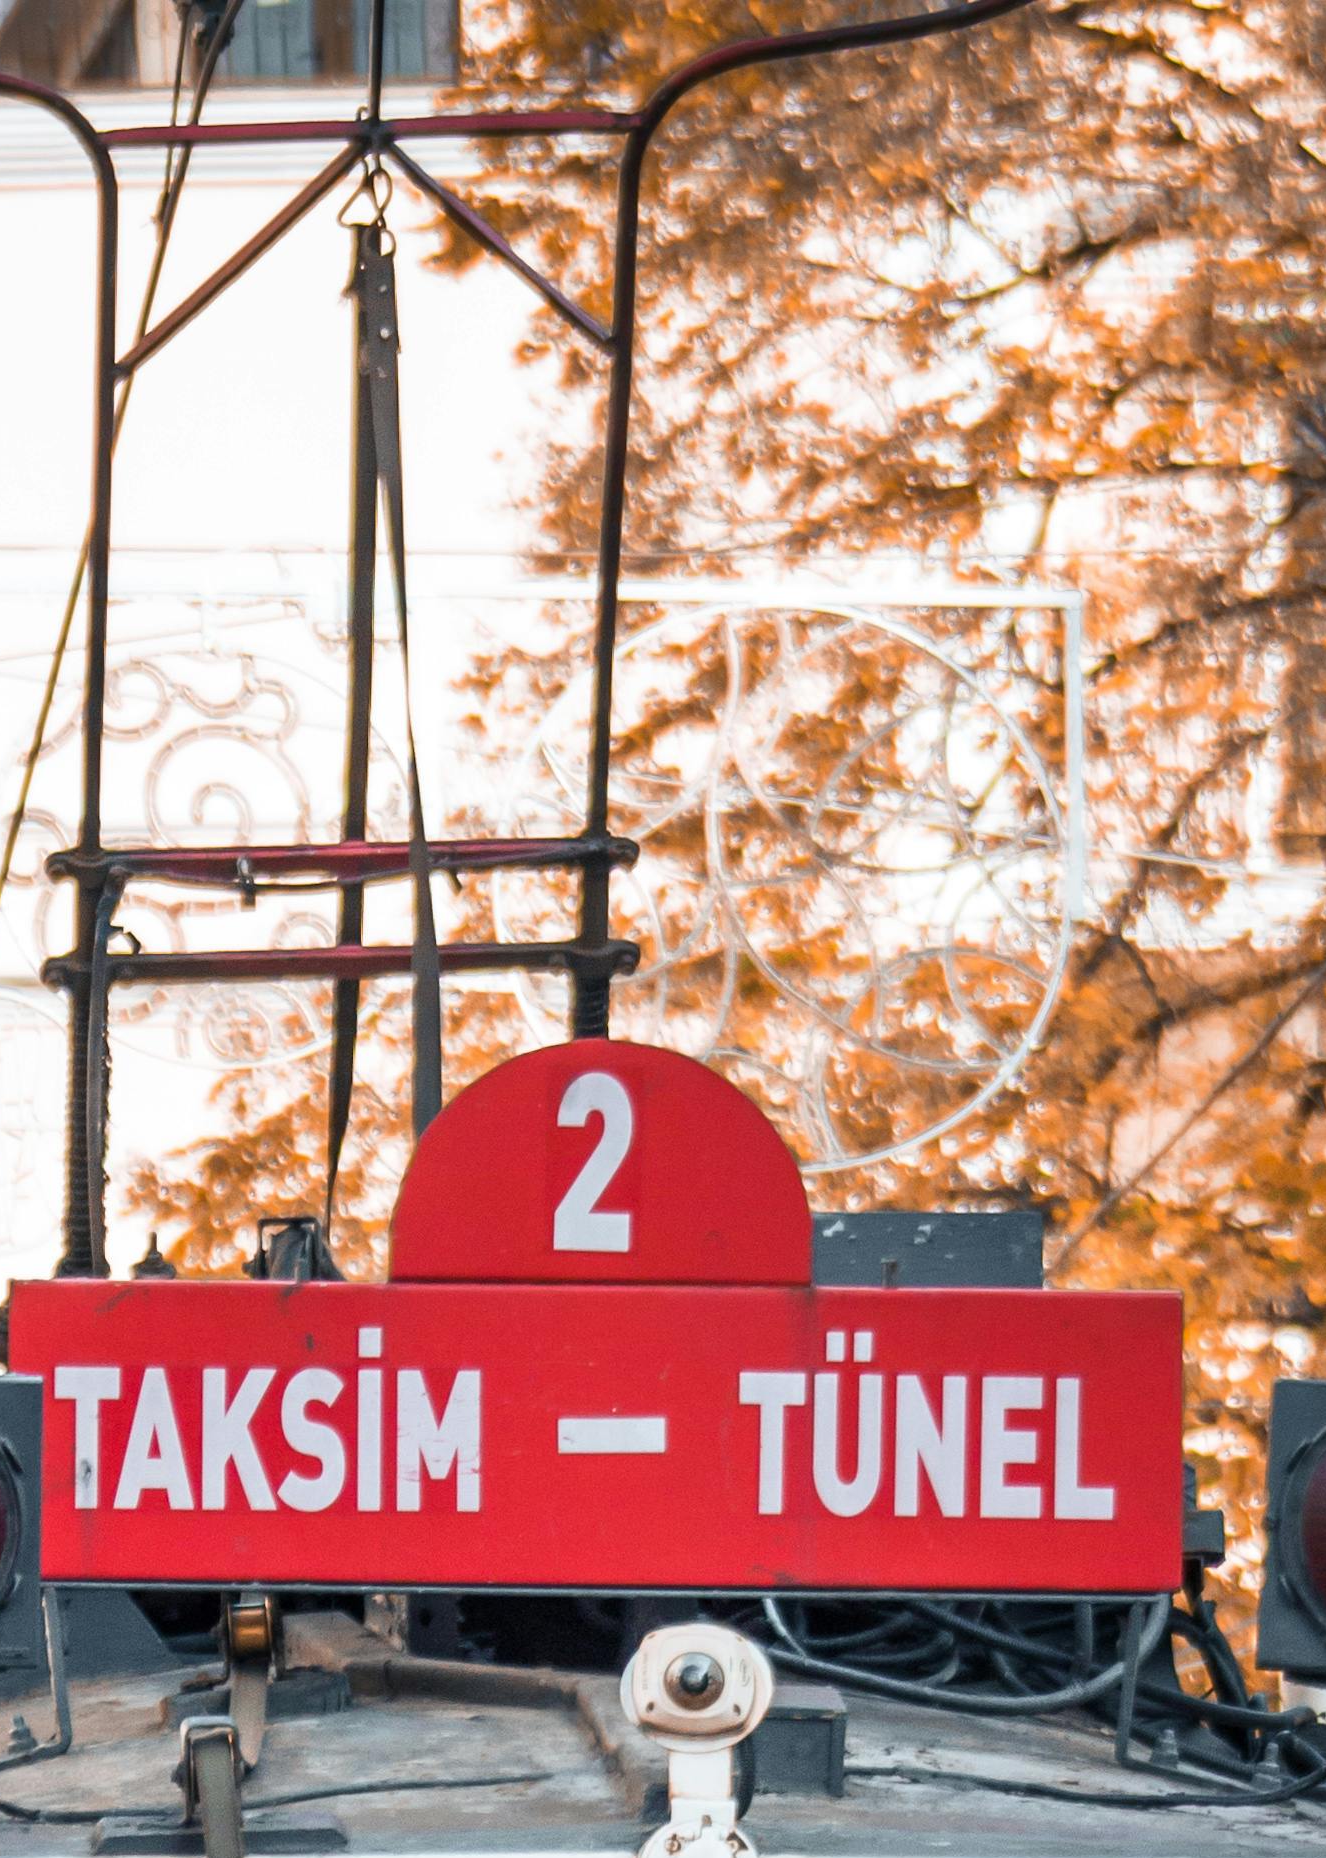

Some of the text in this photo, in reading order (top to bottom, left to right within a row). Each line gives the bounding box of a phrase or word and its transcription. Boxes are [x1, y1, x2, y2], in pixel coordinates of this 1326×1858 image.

[554, 1073, 634, 1252] 2
[54, 1327, 481, 1513] TAKSİM
[738, 1331, 1116, 1520] TÜNEL
